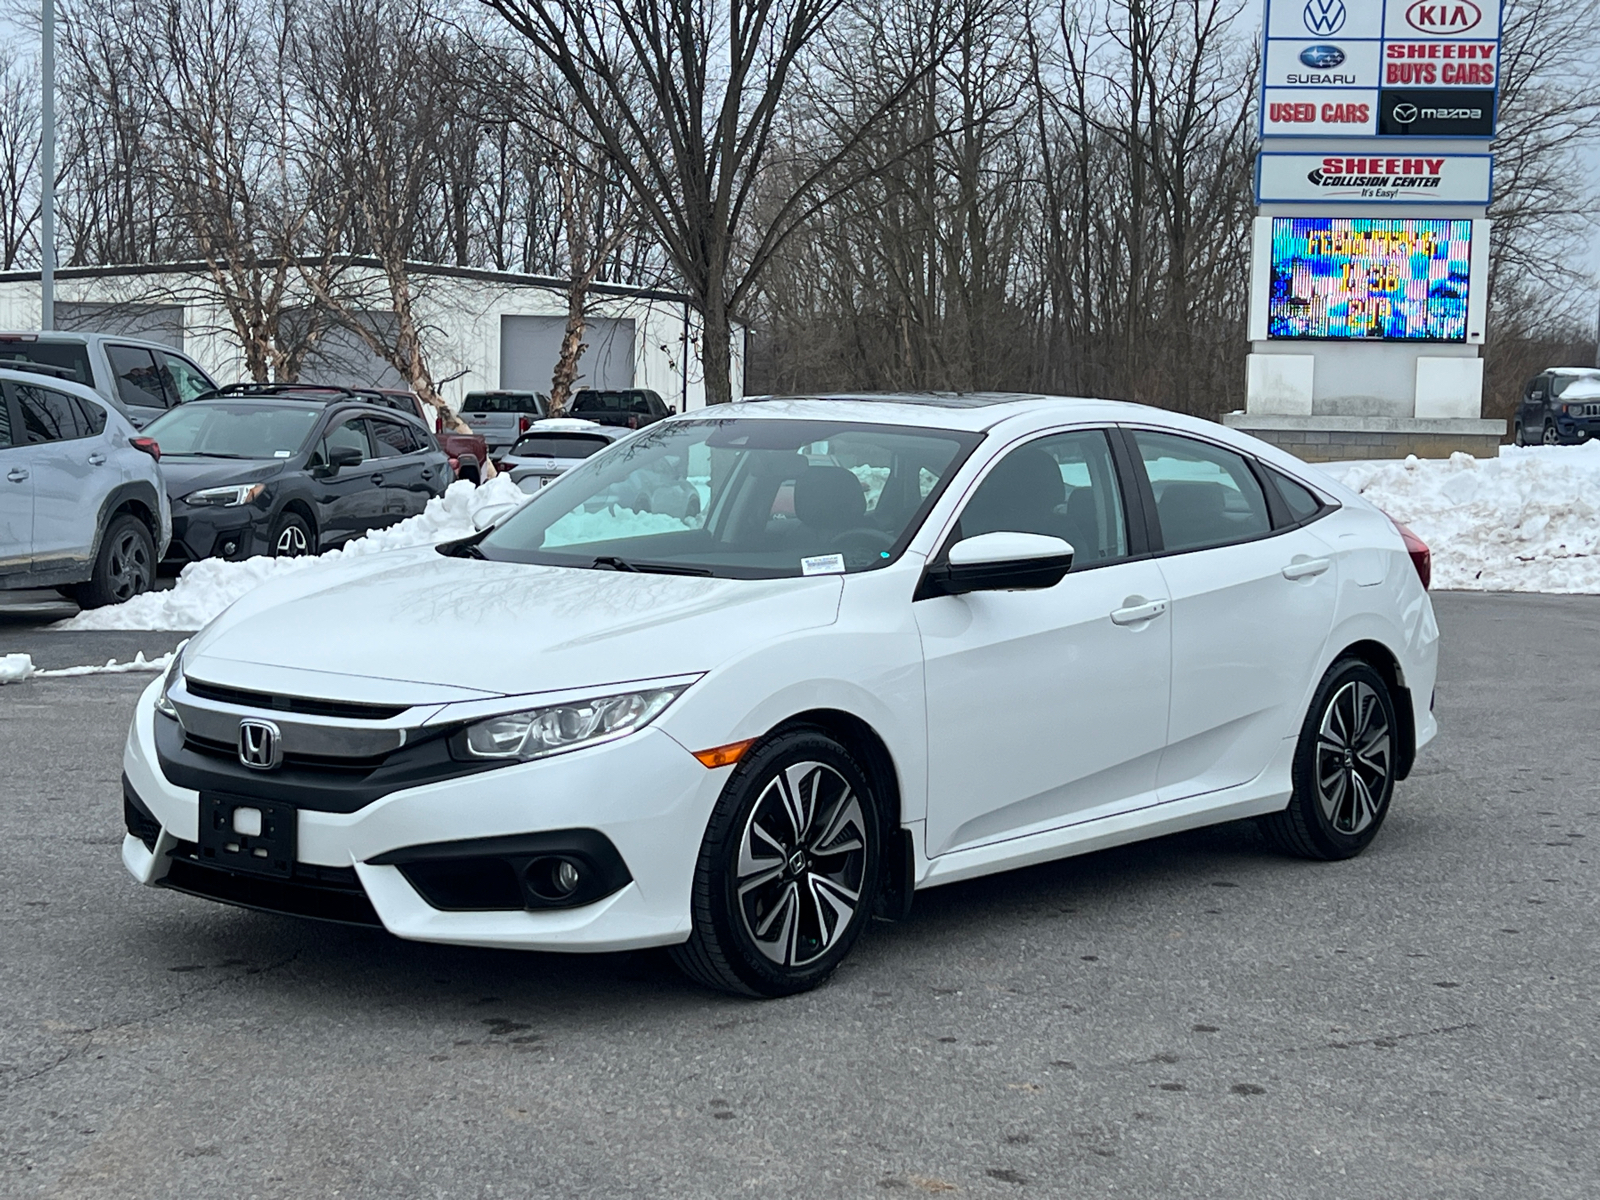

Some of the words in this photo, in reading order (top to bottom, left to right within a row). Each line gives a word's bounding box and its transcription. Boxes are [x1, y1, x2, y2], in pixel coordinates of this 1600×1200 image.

[1419, 5, 1468, 26] KIA
[1386, 44, 1496, 59] SHEEHY
[1286, 74, 1356, 85] SUBARU
[1386, 63, 1437, 85] BUYS
[1441, 63, 1494, 85] CARS
[1269, 103, 1316, 123] USED
[1321, 103, 1370, 123] CARS
[1322, 158, 1445, 175] SHEEHY
[1321, 176, 1390, 187] COLLISION
[1391, 176, 1442, 188] CENTER
[1361, 188, 1374, 197] It's
[1375, 188, 1399, 199] Easy!
